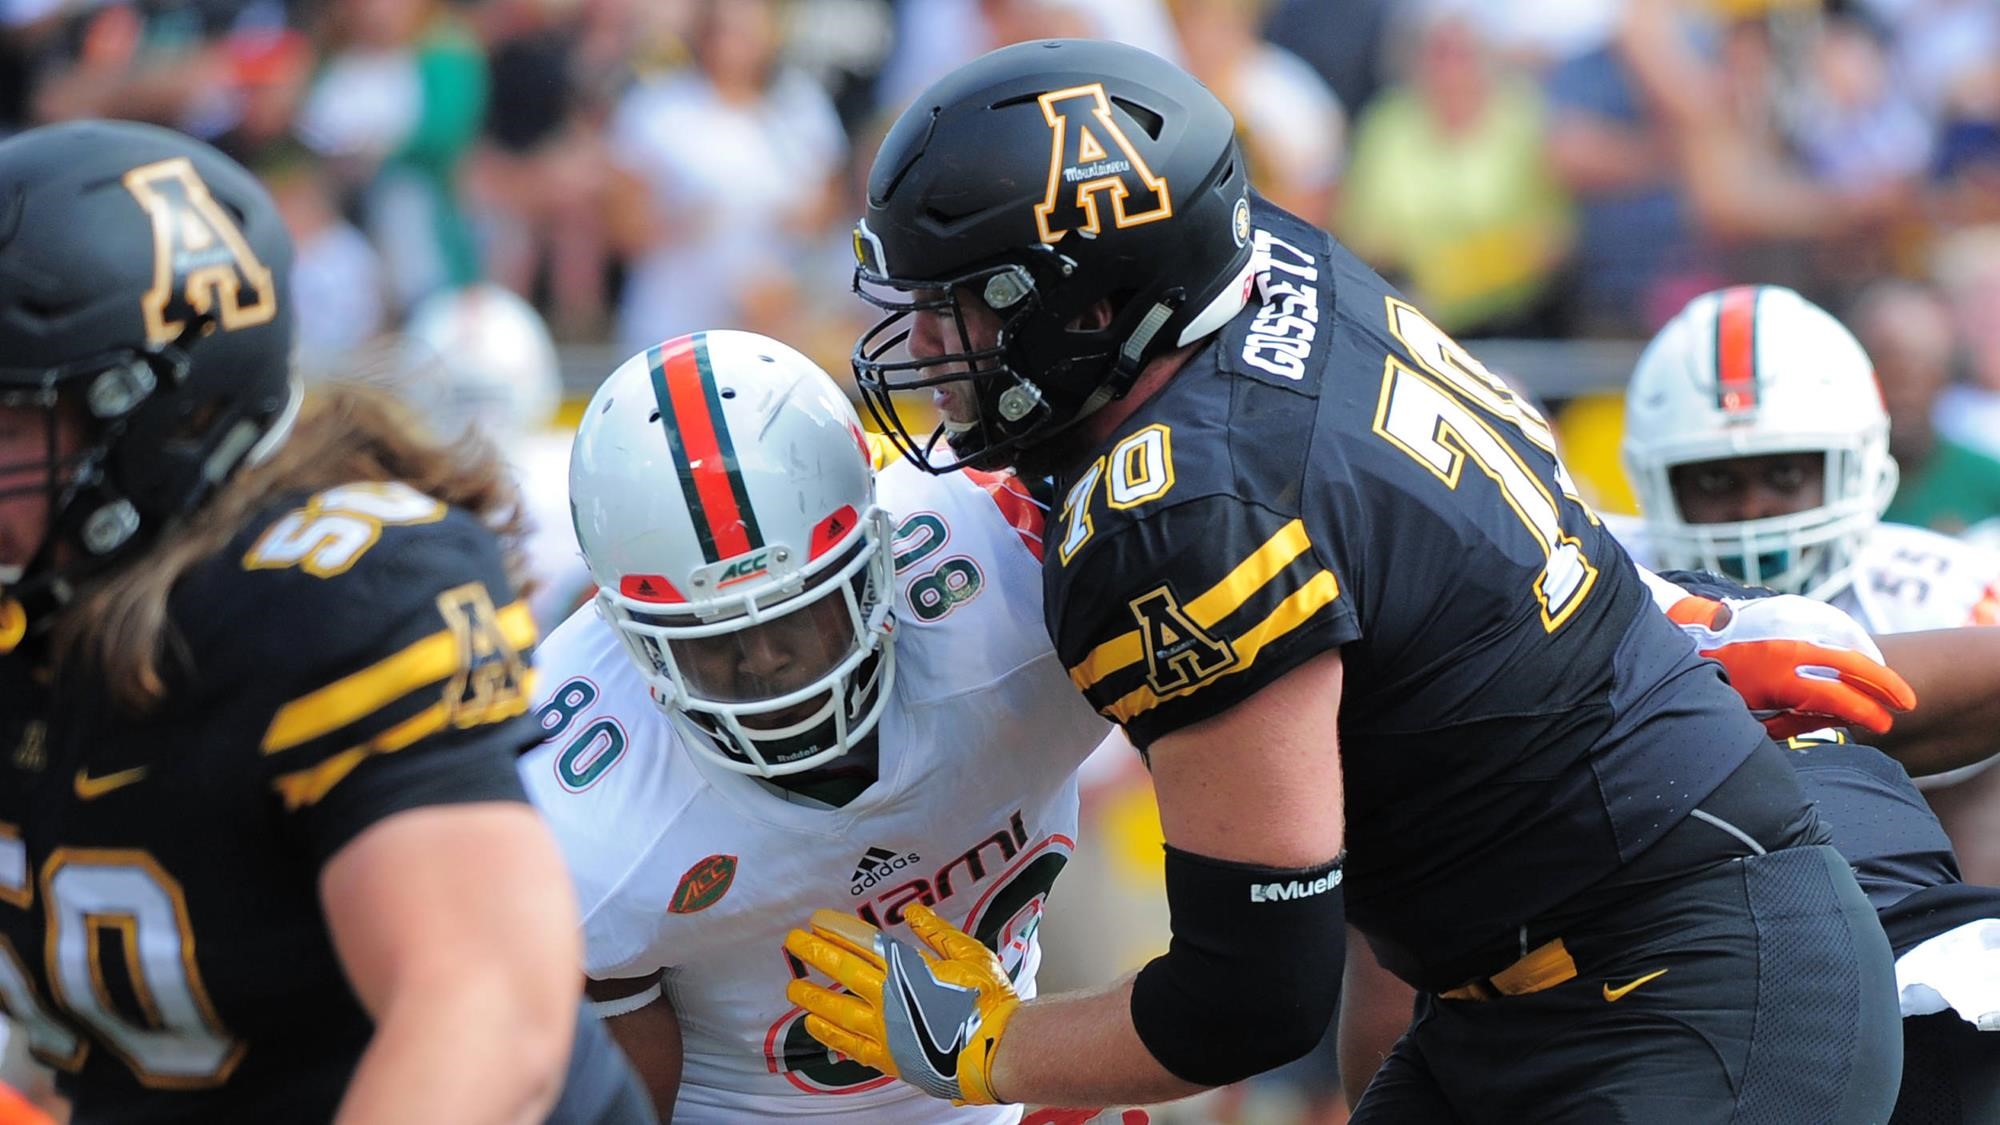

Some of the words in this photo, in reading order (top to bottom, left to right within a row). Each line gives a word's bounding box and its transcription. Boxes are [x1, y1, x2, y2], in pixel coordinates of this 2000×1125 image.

[1034, 83, 1172, 243] A
[122, 156, 277, 346] A
[1242, 229, 1319, 381] GOSSETT
[1059, 423, 1176, 567] 70
[719, 553, 768, 582] ACC
[1128, 584, 1242, 693] A
[535, 675, 629, 794] 80
[680, 857, 728, 911] ACC
[850, 851, 921, 896] adidas
[1267, 867, 1344, 901] Muelle
